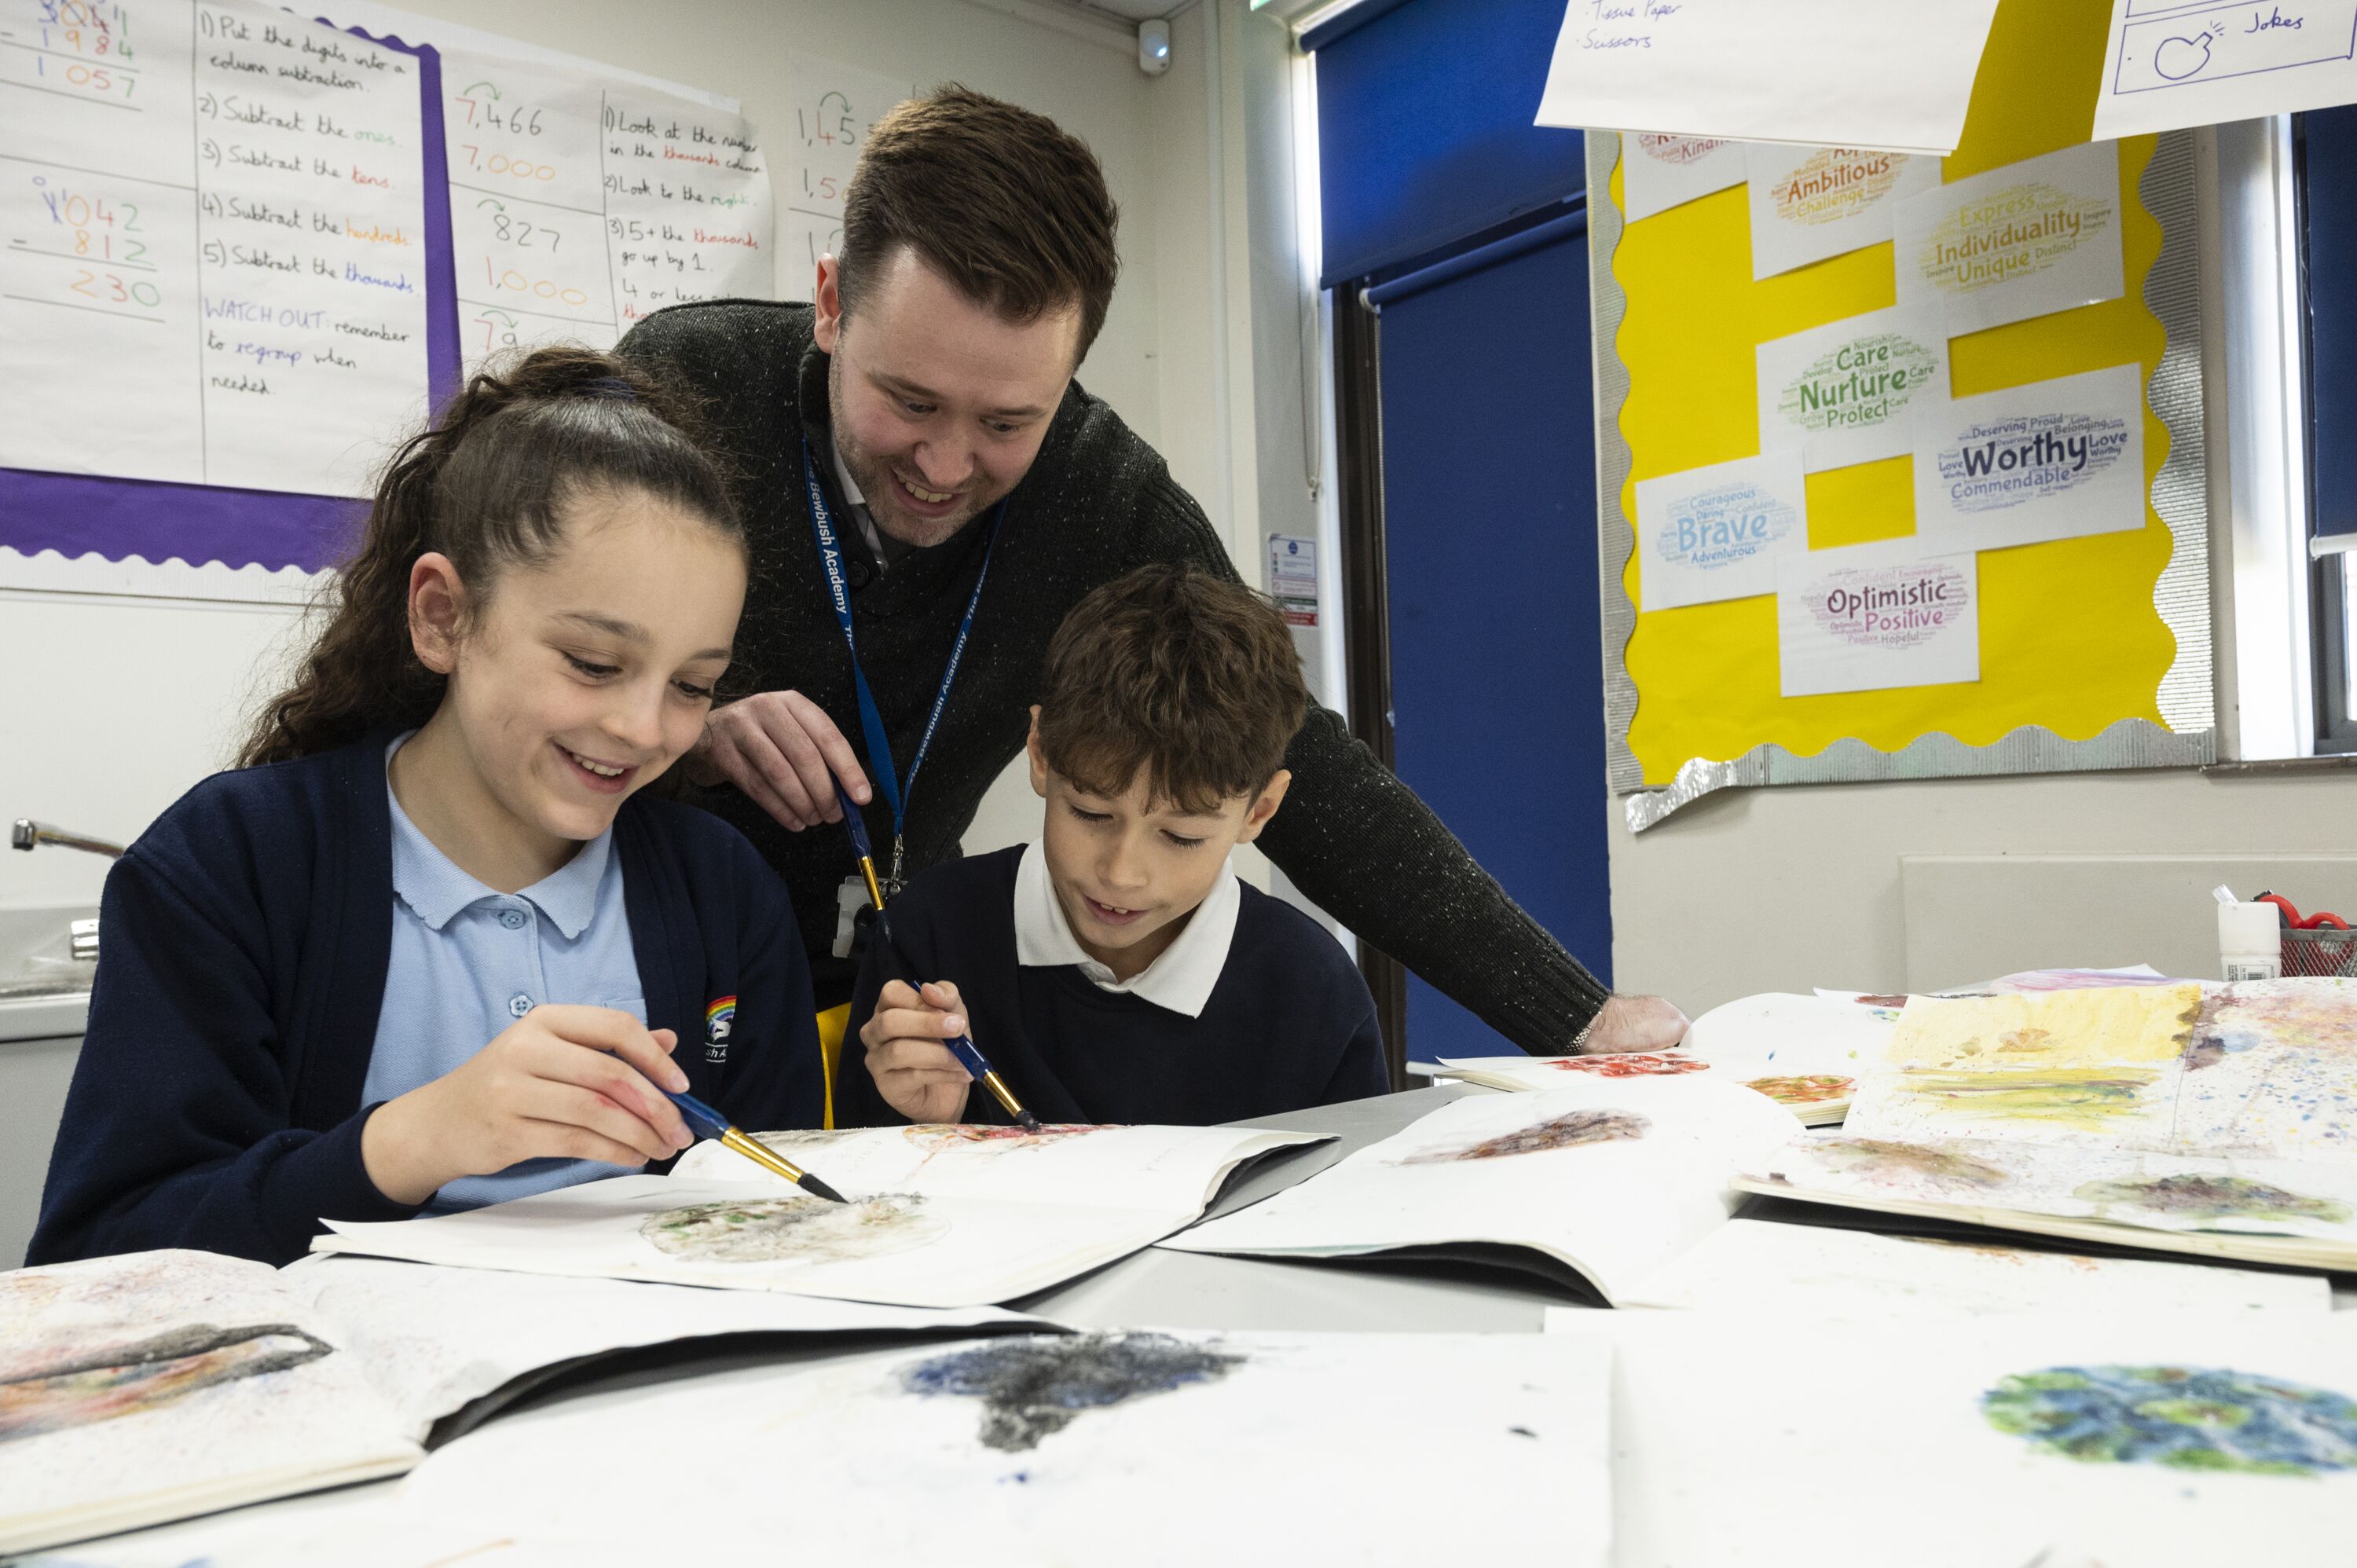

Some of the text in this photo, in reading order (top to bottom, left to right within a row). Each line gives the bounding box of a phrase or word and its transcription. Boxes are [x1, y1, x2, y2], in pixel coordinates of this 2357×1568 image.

[1591, 0, 1683, 21] Tissue Paper
[2244, 6, 2304, 34] Jokes
[220, 16, 250, 40] Put
[265, 26, 295, 48] the
[302, 35, 347, 64] digits
[353, 52, 388, 71] into
[394, 65, 406, 75] a
[1582, 27, 1652, 50] Scissors
[210, 51, 269, 75] column
[224, 95, 306, 132] Subtract
[317, 114, 349, 138] the
[455, 97, 542, 137] 7,466
[619, 112, 658, 138] Look
[665, 122, 680, 140] at
[693, 126, 717, 145] the
[798, 108, 874, 147] 1,45
[228, 145, 302, 172] Subtract
[313, 158, 342, 179] the
[462, 145, 556, 181] 7,000
[610, 142, 624, 156] in
[634, 144, 654, 159] the
[663, 145, 720, 167] thousands
[620, 175, 652, 196] Look
[661, 181, 673, 199] to
[683, 185, 705, 204] the
[1787, 156, 1890, 203] Ambitious
[229, 196, 303, 229] Subtract
[313, 211, 342, 235] the
[1796, 188, 1865, 218] Challenge
[1959, 193, 2036, 229] Express
[493, 214, 561, 253] 827
[662, 225, 685, 241] the
[694, 228, 760, 250] thousands
[1936, 208, 2081, 266] Individuality
[232, 244, 302, 273] Subtract
[313, 257, 339, 279] the
[621, 251, 636, 266] go
[643, 254, 659, 268] up
[666, 250, 685, 273] by
[1956, 251, 2032, 284] Unique
[486, 256, 588, 306] 1,000
[623, 277, 638, 299] 4
[651, 290, 666, 300] or
[204, 297, 272, 323] WATCH
[335, 323, 411, 343] remember
[207, 330, 357, 369] to regroup when
[1836, 346, 1889, 371] Care
[1909, 365, 1935, 378] Care
[1799, 369, 1907, 414] Nurture
[1827, 397, 1889, 428] Protect
[1972, 421, 2027, 439] Deserving
[2030, 413, 2063, 429] Proud
[2055, 419, 2106, 435] Belonging
[1938, 460, 1964, 471] Love
[1963, 430, 2128, 478] Worthy Love
[1690, 489, 1757, 510] Courageous
[1951, 465, 2071, 500] Commendable
[810, 481, 836, 546] Bewbush
[823, 548, 848, 614] Academy
[1677, 515, 1768, 553] Brave
[1827, 578, 1948, 619] Optimistic
[1864, 608, 1945, 632] Positive
[1881, 631, 1920, 647] Hopeful
[943, 631, 968, 695] Academy
